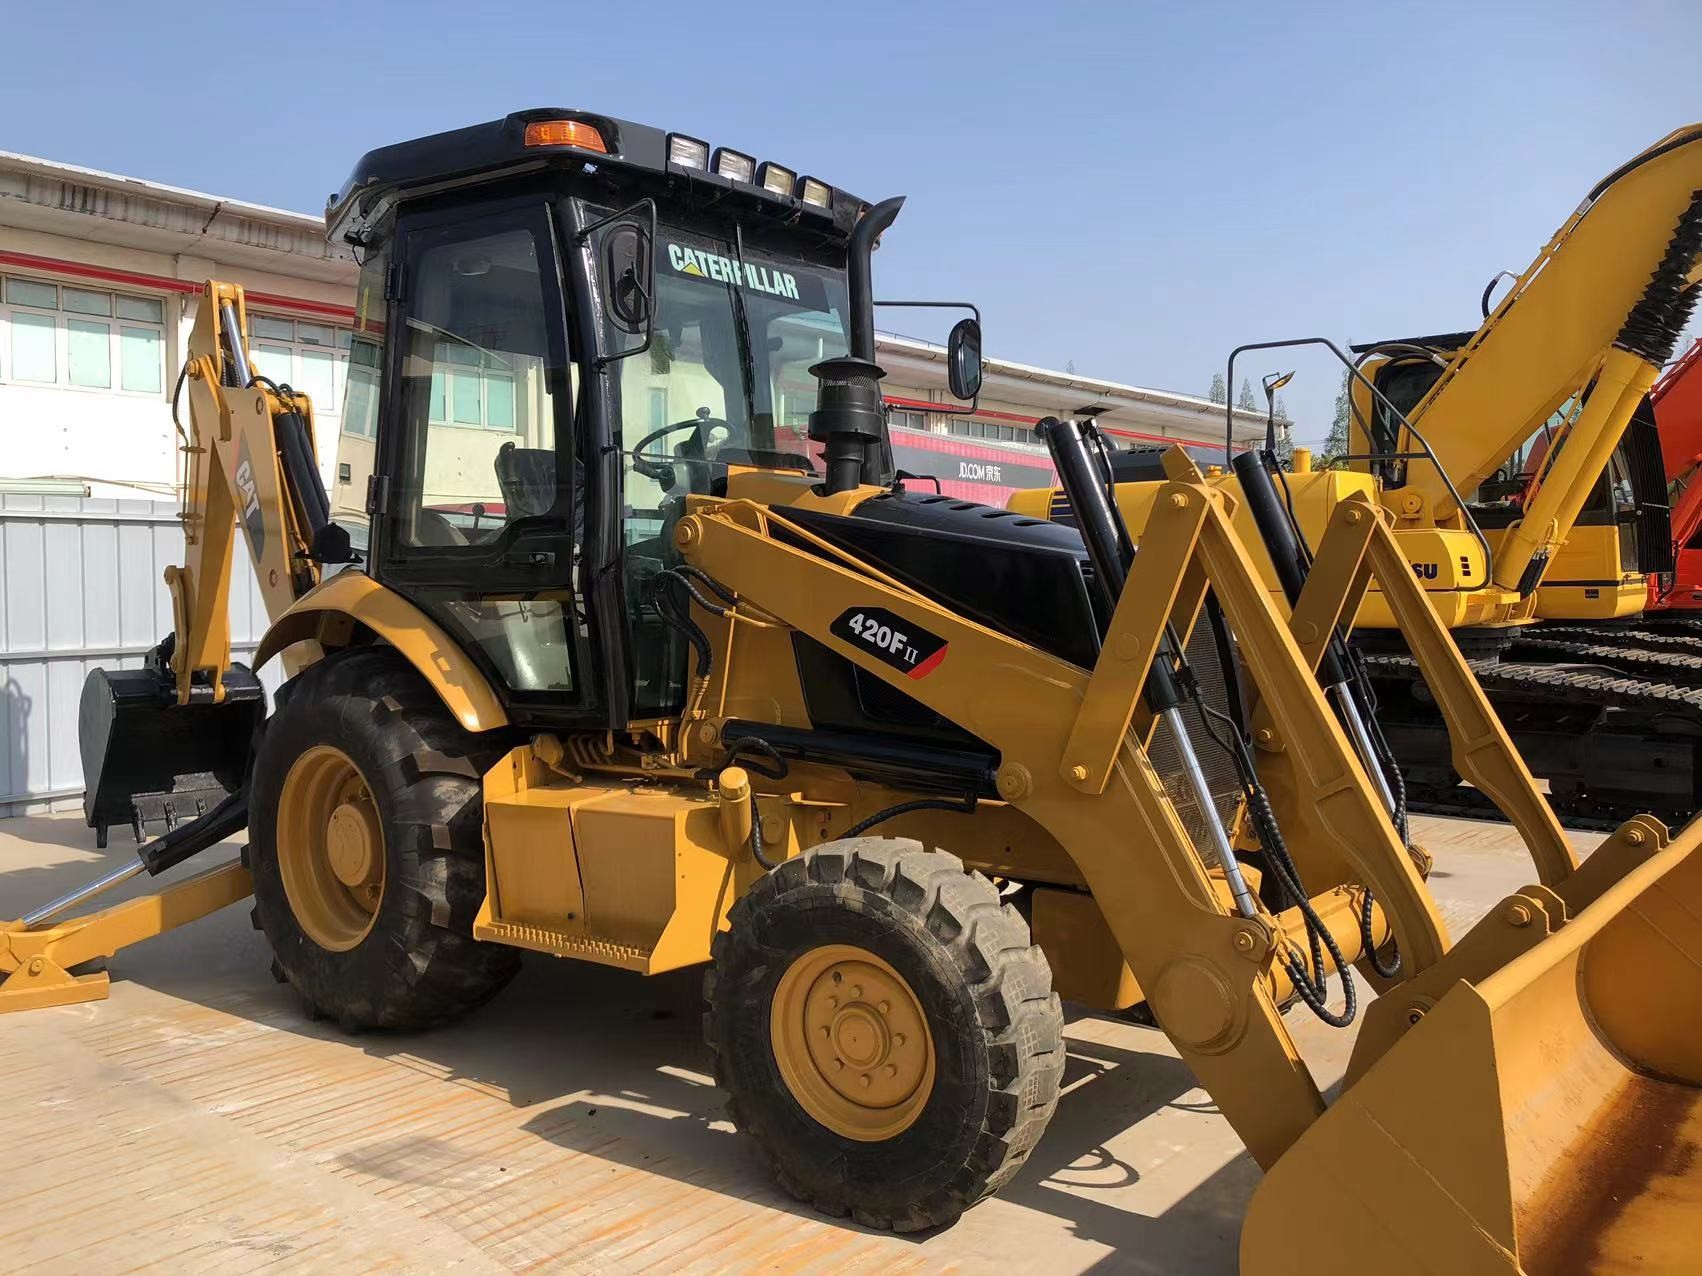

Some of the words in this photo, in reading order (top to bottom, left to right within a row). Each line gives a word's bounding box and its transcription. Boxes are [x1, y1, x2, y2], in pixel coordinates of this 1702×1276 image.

[958, 461, 985, 480] JD.COM
[985, 465, 1001, 482] 京东
[236, 460, 260, 520] CAT
[1408, 560, 1438, 579] SU
[848, 613, 908, 654] 420F
